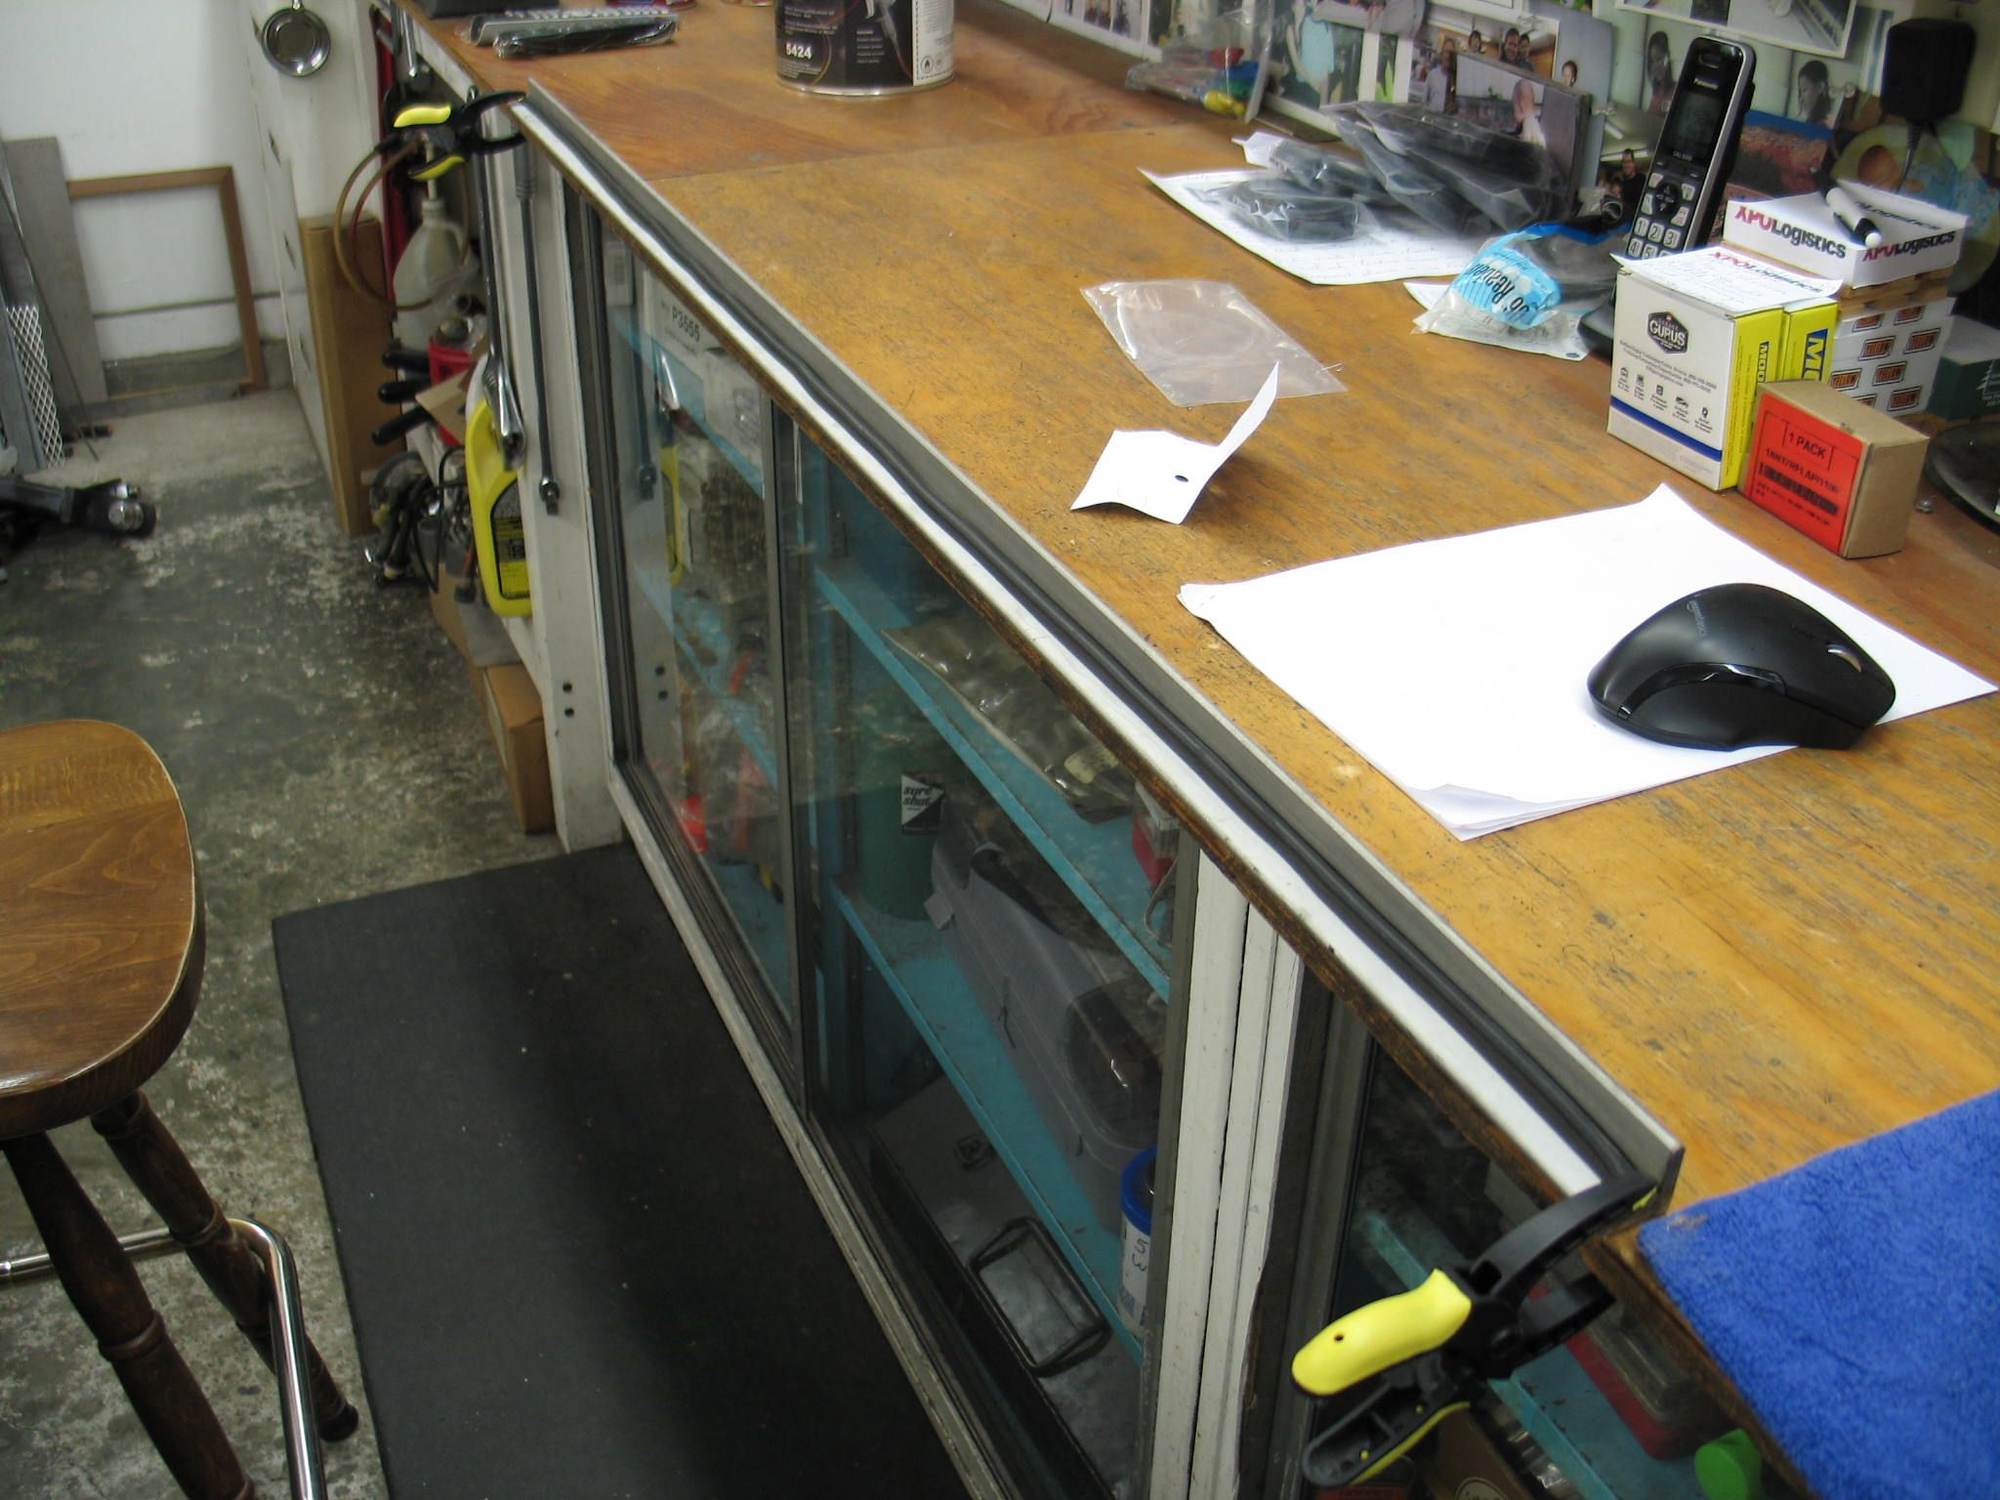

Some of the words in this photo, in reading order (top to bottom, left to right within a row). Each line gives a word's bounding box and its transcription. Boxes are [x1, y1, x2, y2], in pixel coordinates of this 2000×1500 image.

[786, 42, 812, 60] 5424
[1649, 319, 1686, 347] GURUS
[1796, 436, 1827, 459] PACK
